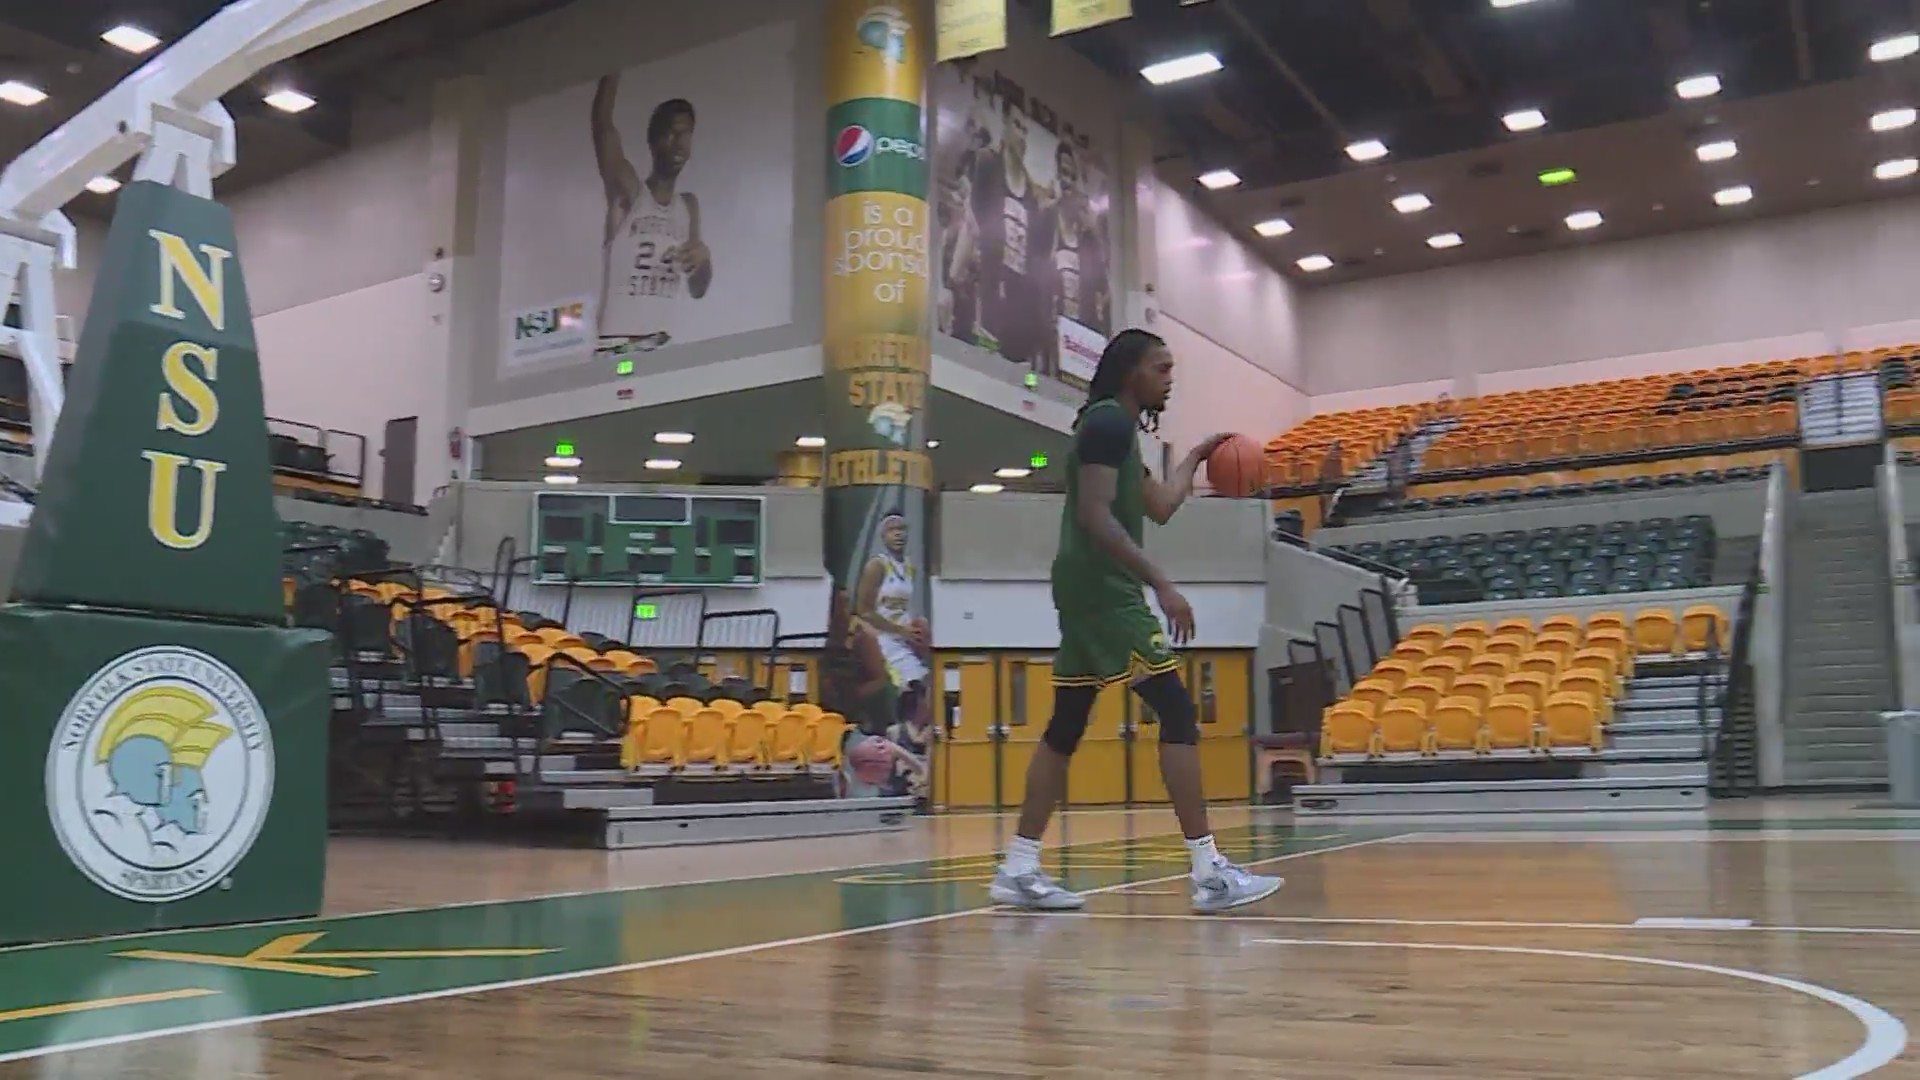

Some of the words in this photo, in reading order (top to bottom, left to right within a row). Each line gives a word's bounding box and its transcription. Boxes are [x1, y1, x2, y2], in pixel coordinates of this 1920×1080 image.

[864, 201, 882, 225] is
[893, 206, 914, 228] a
[874, 278, 906, 304] of
